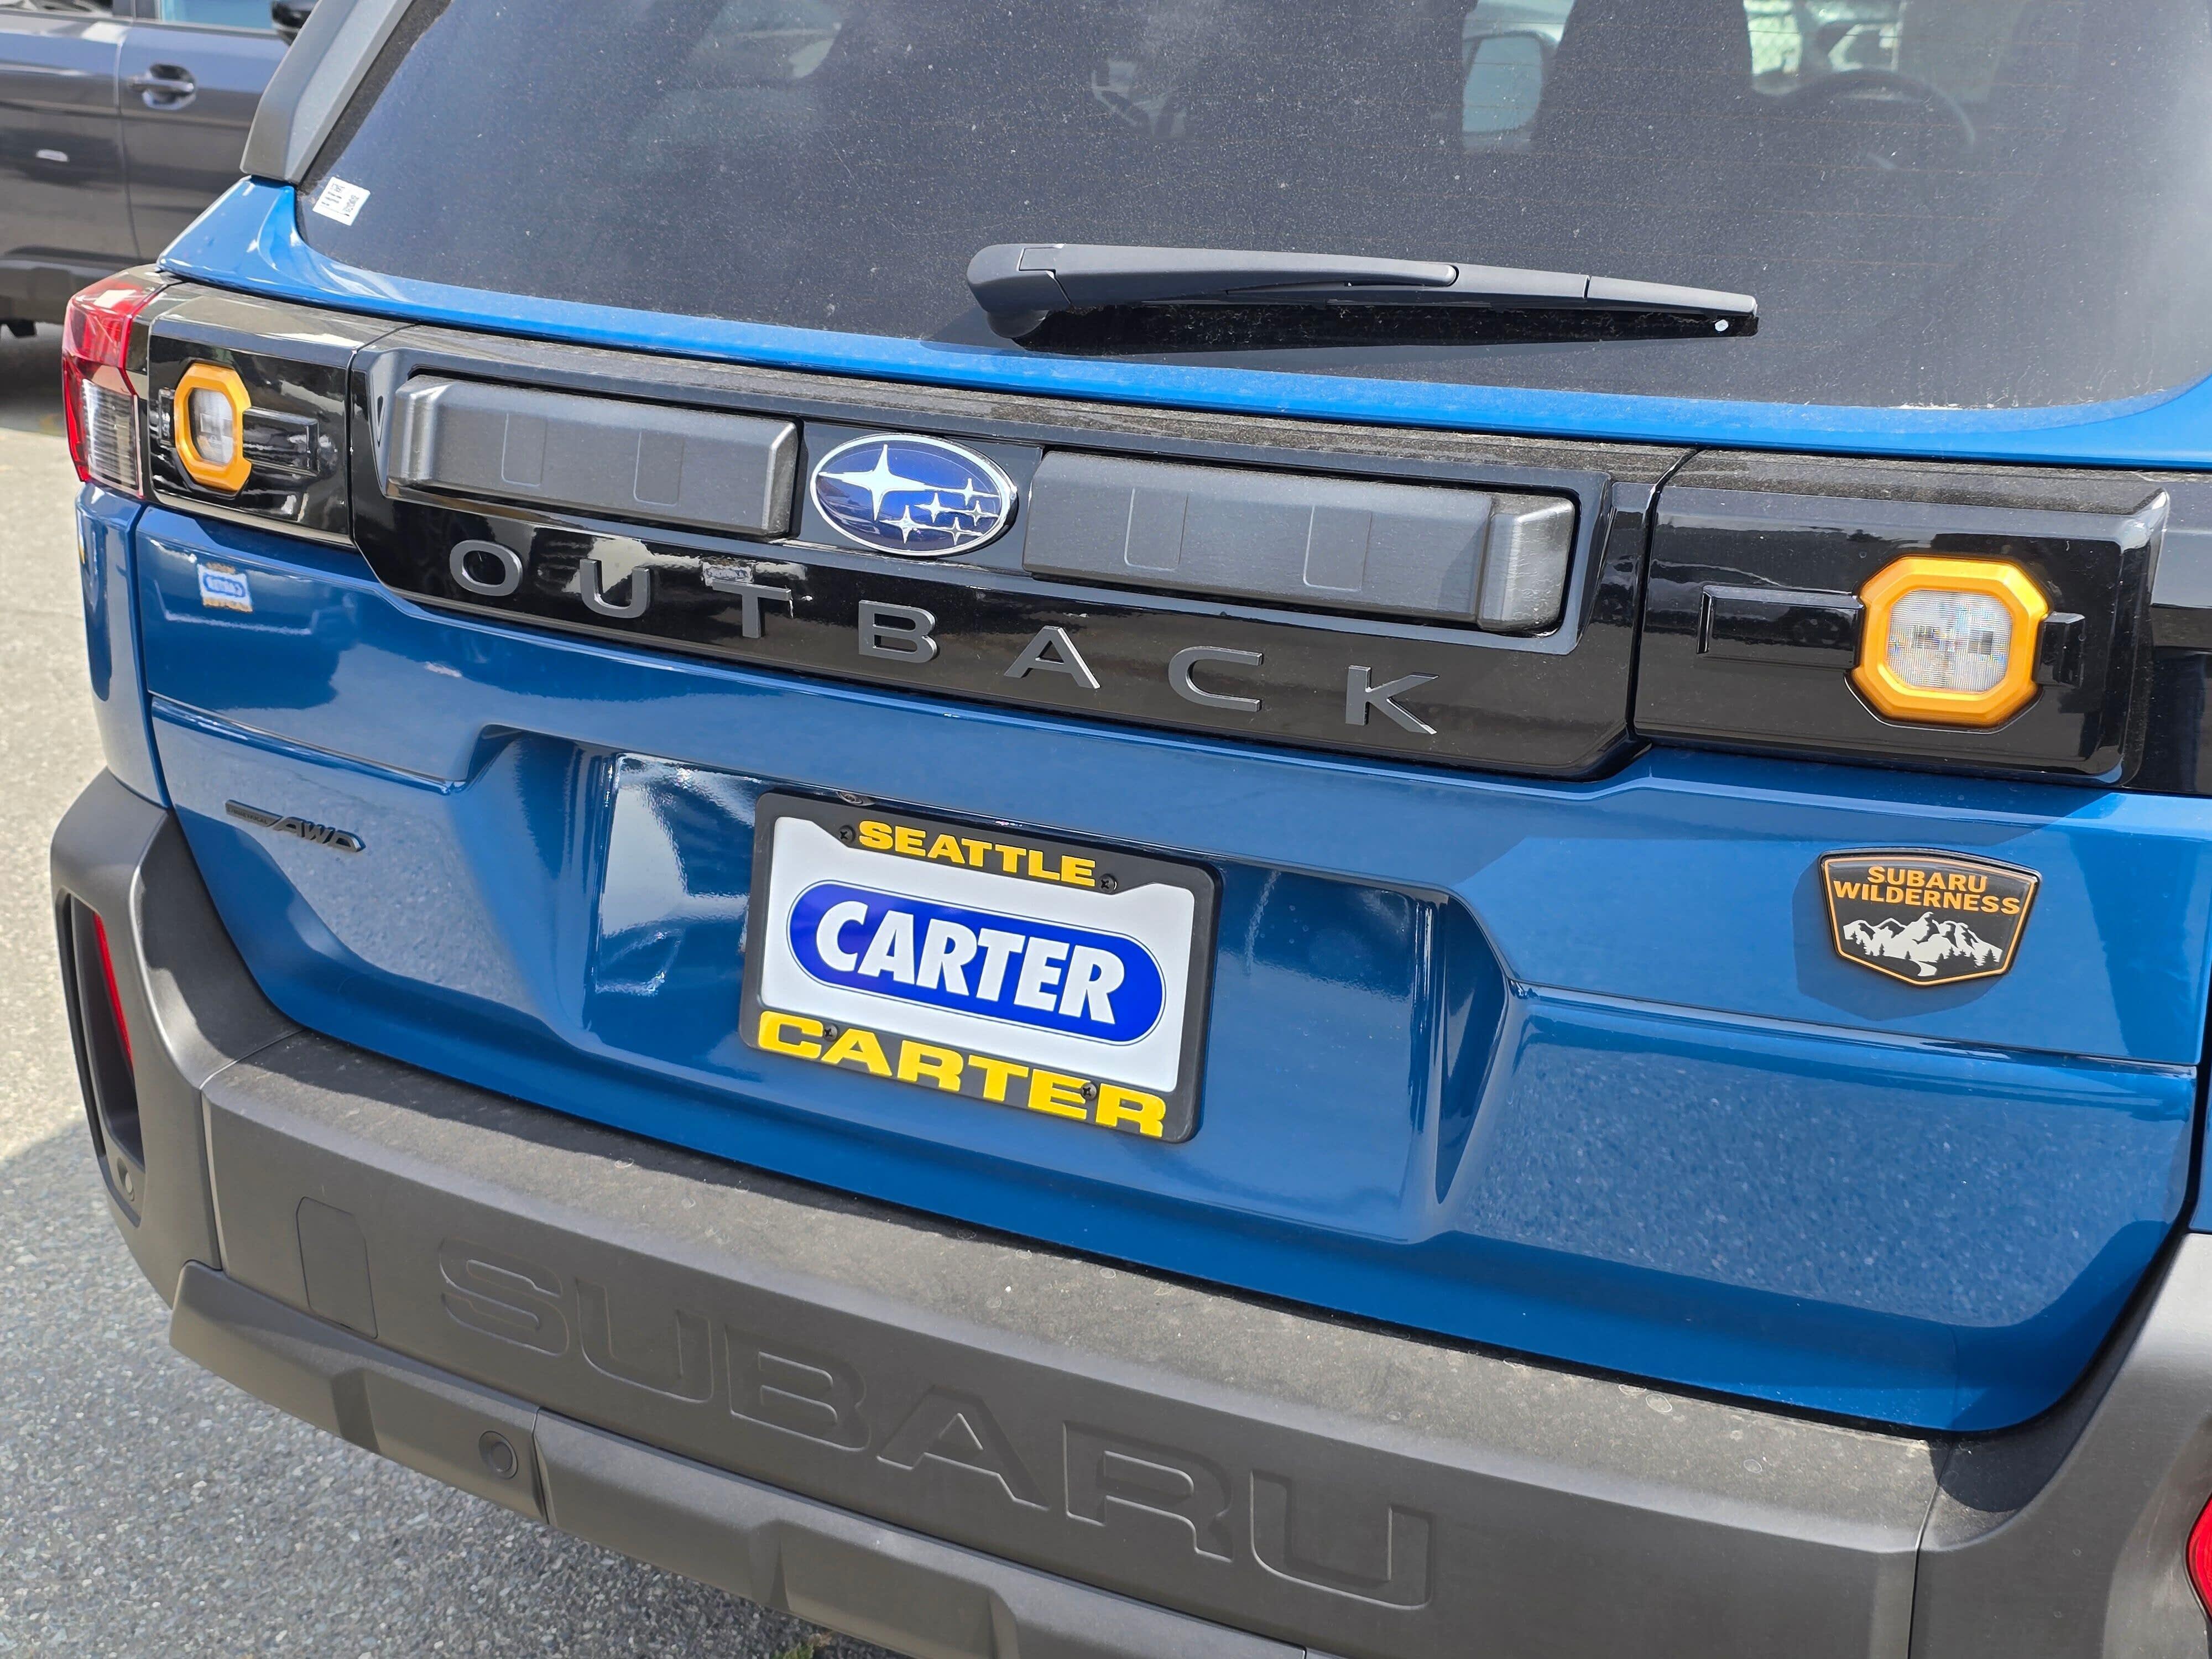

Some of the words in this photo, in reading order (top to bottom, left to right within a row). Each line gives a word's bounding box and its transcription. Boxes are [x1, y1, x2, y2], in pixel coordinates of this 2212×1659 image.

[449, 539, 1438, 734] OUTBACK
[273, 817, 365, 852] AWD
[859, 820, 1096, 887] SEATTLE
[1866, 867, 1987, 893] SUBARU
[1833, 880, 2020, 915] WILDERNESS
[816, 900, 1125, 1025] CARTER
[758, 1011, 1166, 1138] CARTER
[440, 1237, 1434, 1610] SUBARU
